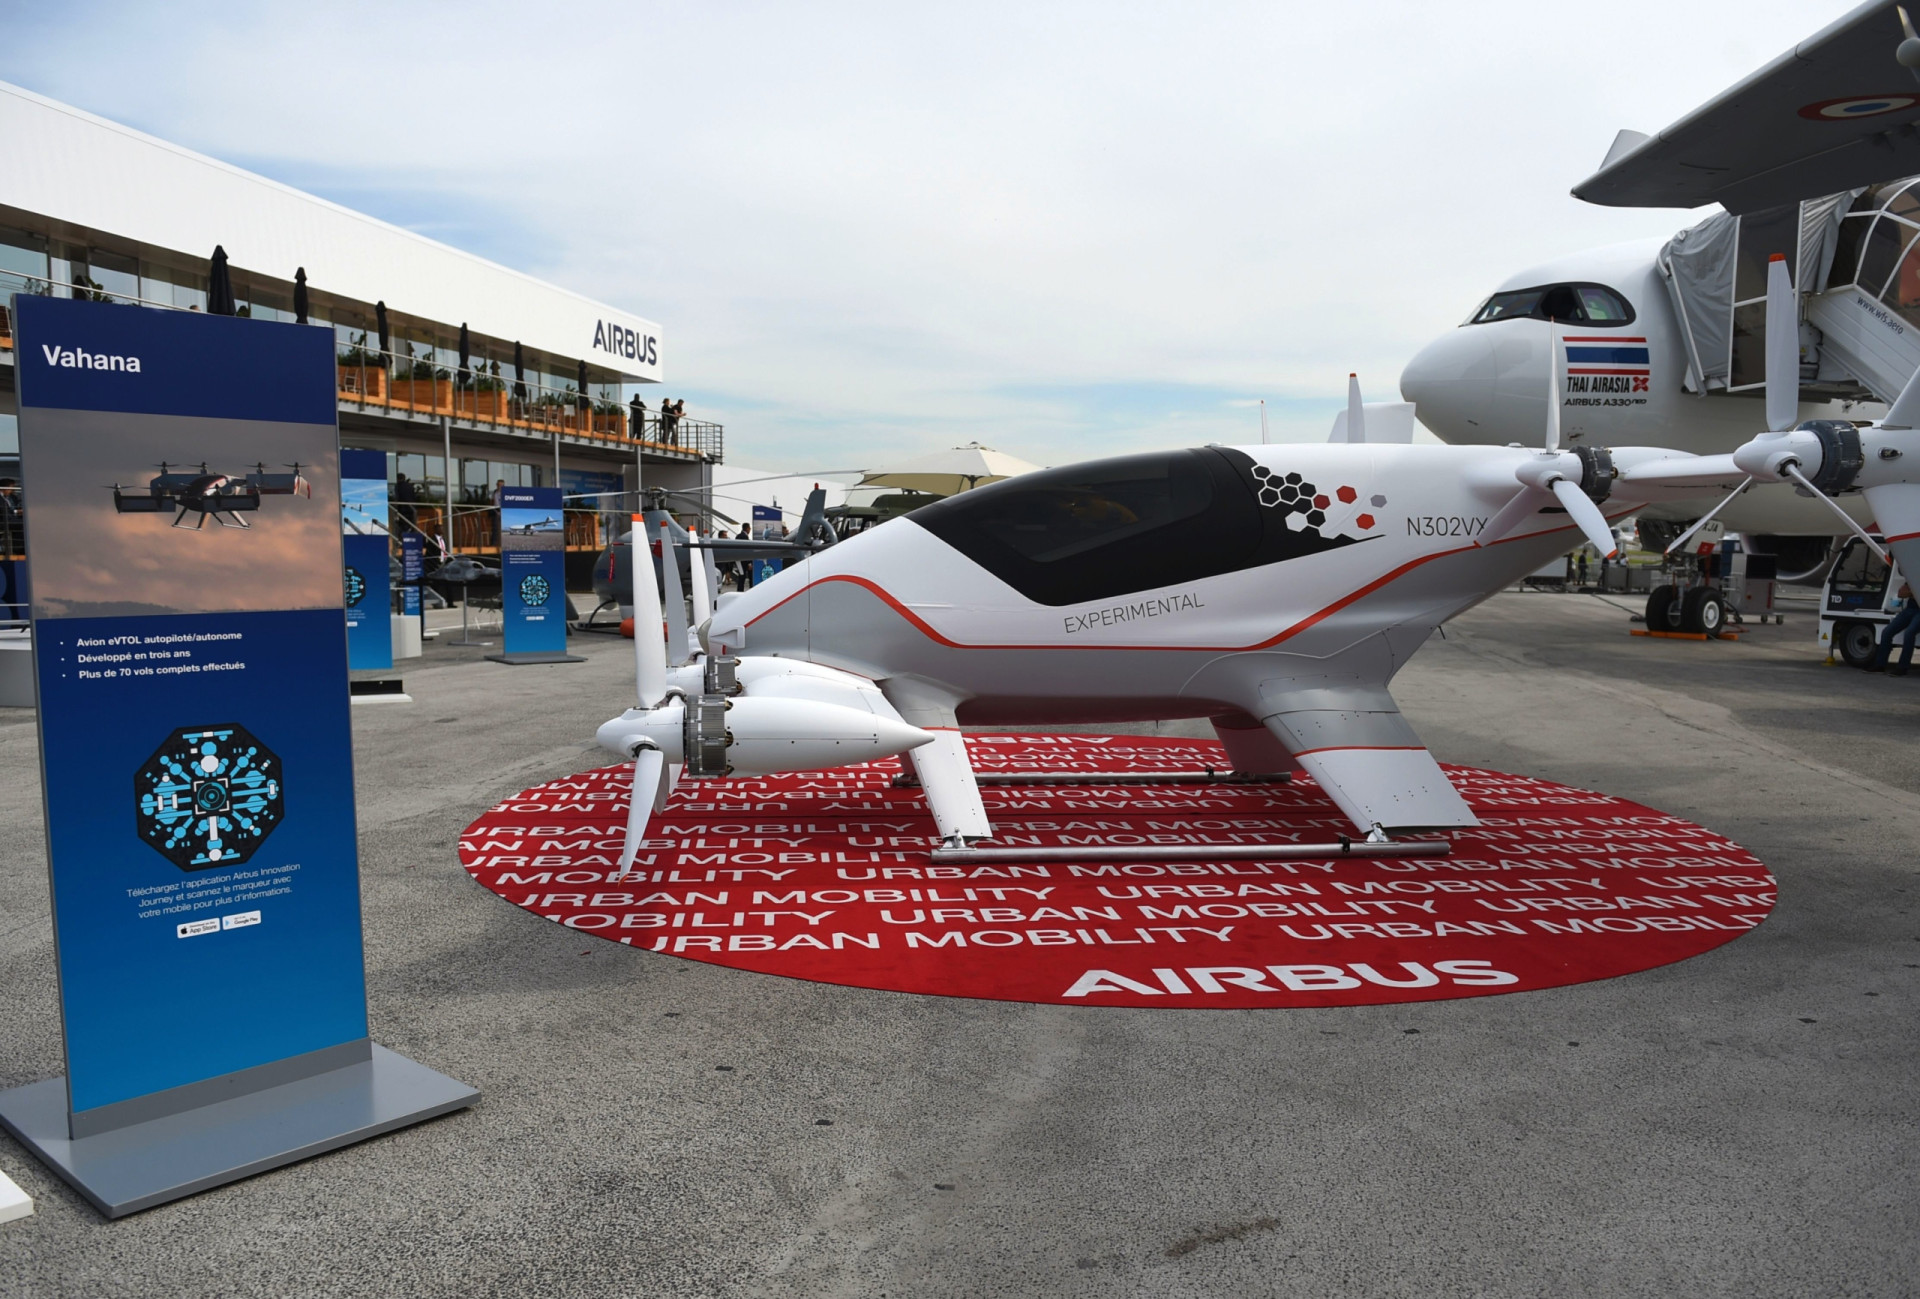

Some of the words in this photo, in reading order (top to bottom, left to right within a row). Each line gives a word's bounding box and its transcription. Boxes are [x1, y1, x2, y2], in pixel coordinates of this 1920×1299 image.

[1857, 296, 1904, 335] www.wfs.aero
[593, 319, 657, 366] AIRBUS
[42, 344, 141, 373] Vahana
[1567, 376, 1589, 393] THAI
[1591, 376, 1630, 393] AIRASIA
[1564, 398, 1602, 406] AIRBUS
[1407, 516, 1488, 537] N302VX
[1064, 592, 1205, 634] EXPERIMENTAL
[76, 637, 106, 647] Avion
[108, 635, 142, 645] eVTOL
[144, 632, 243, 645] autopiloté/autonome
[77, 651, 132, 663] Développé
[149, 650, 172, 659] trois
[173, 650, 191, 658] ans
[79, 669, 102, 679] Plus
[104, 668, 117, 678] de
[119, 668, 131, 677] 70
[134, 666, 154, 676] vols
[156, 664, 201, 676] complets
[202, 661, 246, 672] effectués
[716, 791, 883, 800] URBAN
[1065, 799, 1234, 808] URBAN
[662, 823, 914, 835] MOBILITY
[1146, 818, 1352, 831] MOBILIT
[1057, 833, 1302, 845] MOBILITY
[1485, 842, 1680, 855] URBAN
[126, 882, 180, 898] Téléchargez
[233, 869, 259, 881] Airbus
[260, 863, 301, 876] Innovation
[495, 869, 798, 885] MOBILITY
[836, 865, 1052, 880] URBAN
[1066, 861, 1336, 877] MOBILITY
[1371, 859, 1579, 872] URBAN
[138, 895, 174, 908] Journey
[176, 893, 184, 901] et
[186, 888, 222, 899] scannez
[223, 885, 231, 893] le
[232, 879, 271, 892] marqueur
[273, 875, 292, 885] avec
[752, 887, 1056, 904] MOBILITY
[1096, 882, 1323, 899] URBAN
[1330, 878, 1608, 894] MOBILITY
[138, 908, 161, 919] votre
[162, 902, 192, 915] mobile
[193, 899, 213, 911] pour
[215, 895, 232, 907] plus
[880, 906, 1123, 924] URBAN
[1137, 899, 1438, 919] MOBILITY
[1474, 895, 1704, 913] URBAN
[905, 926, 1235, 948] MOBILITY
[1278, 920, 1529, 941] URBAN
[1061, 960, 1520, 998] AIRBUS
